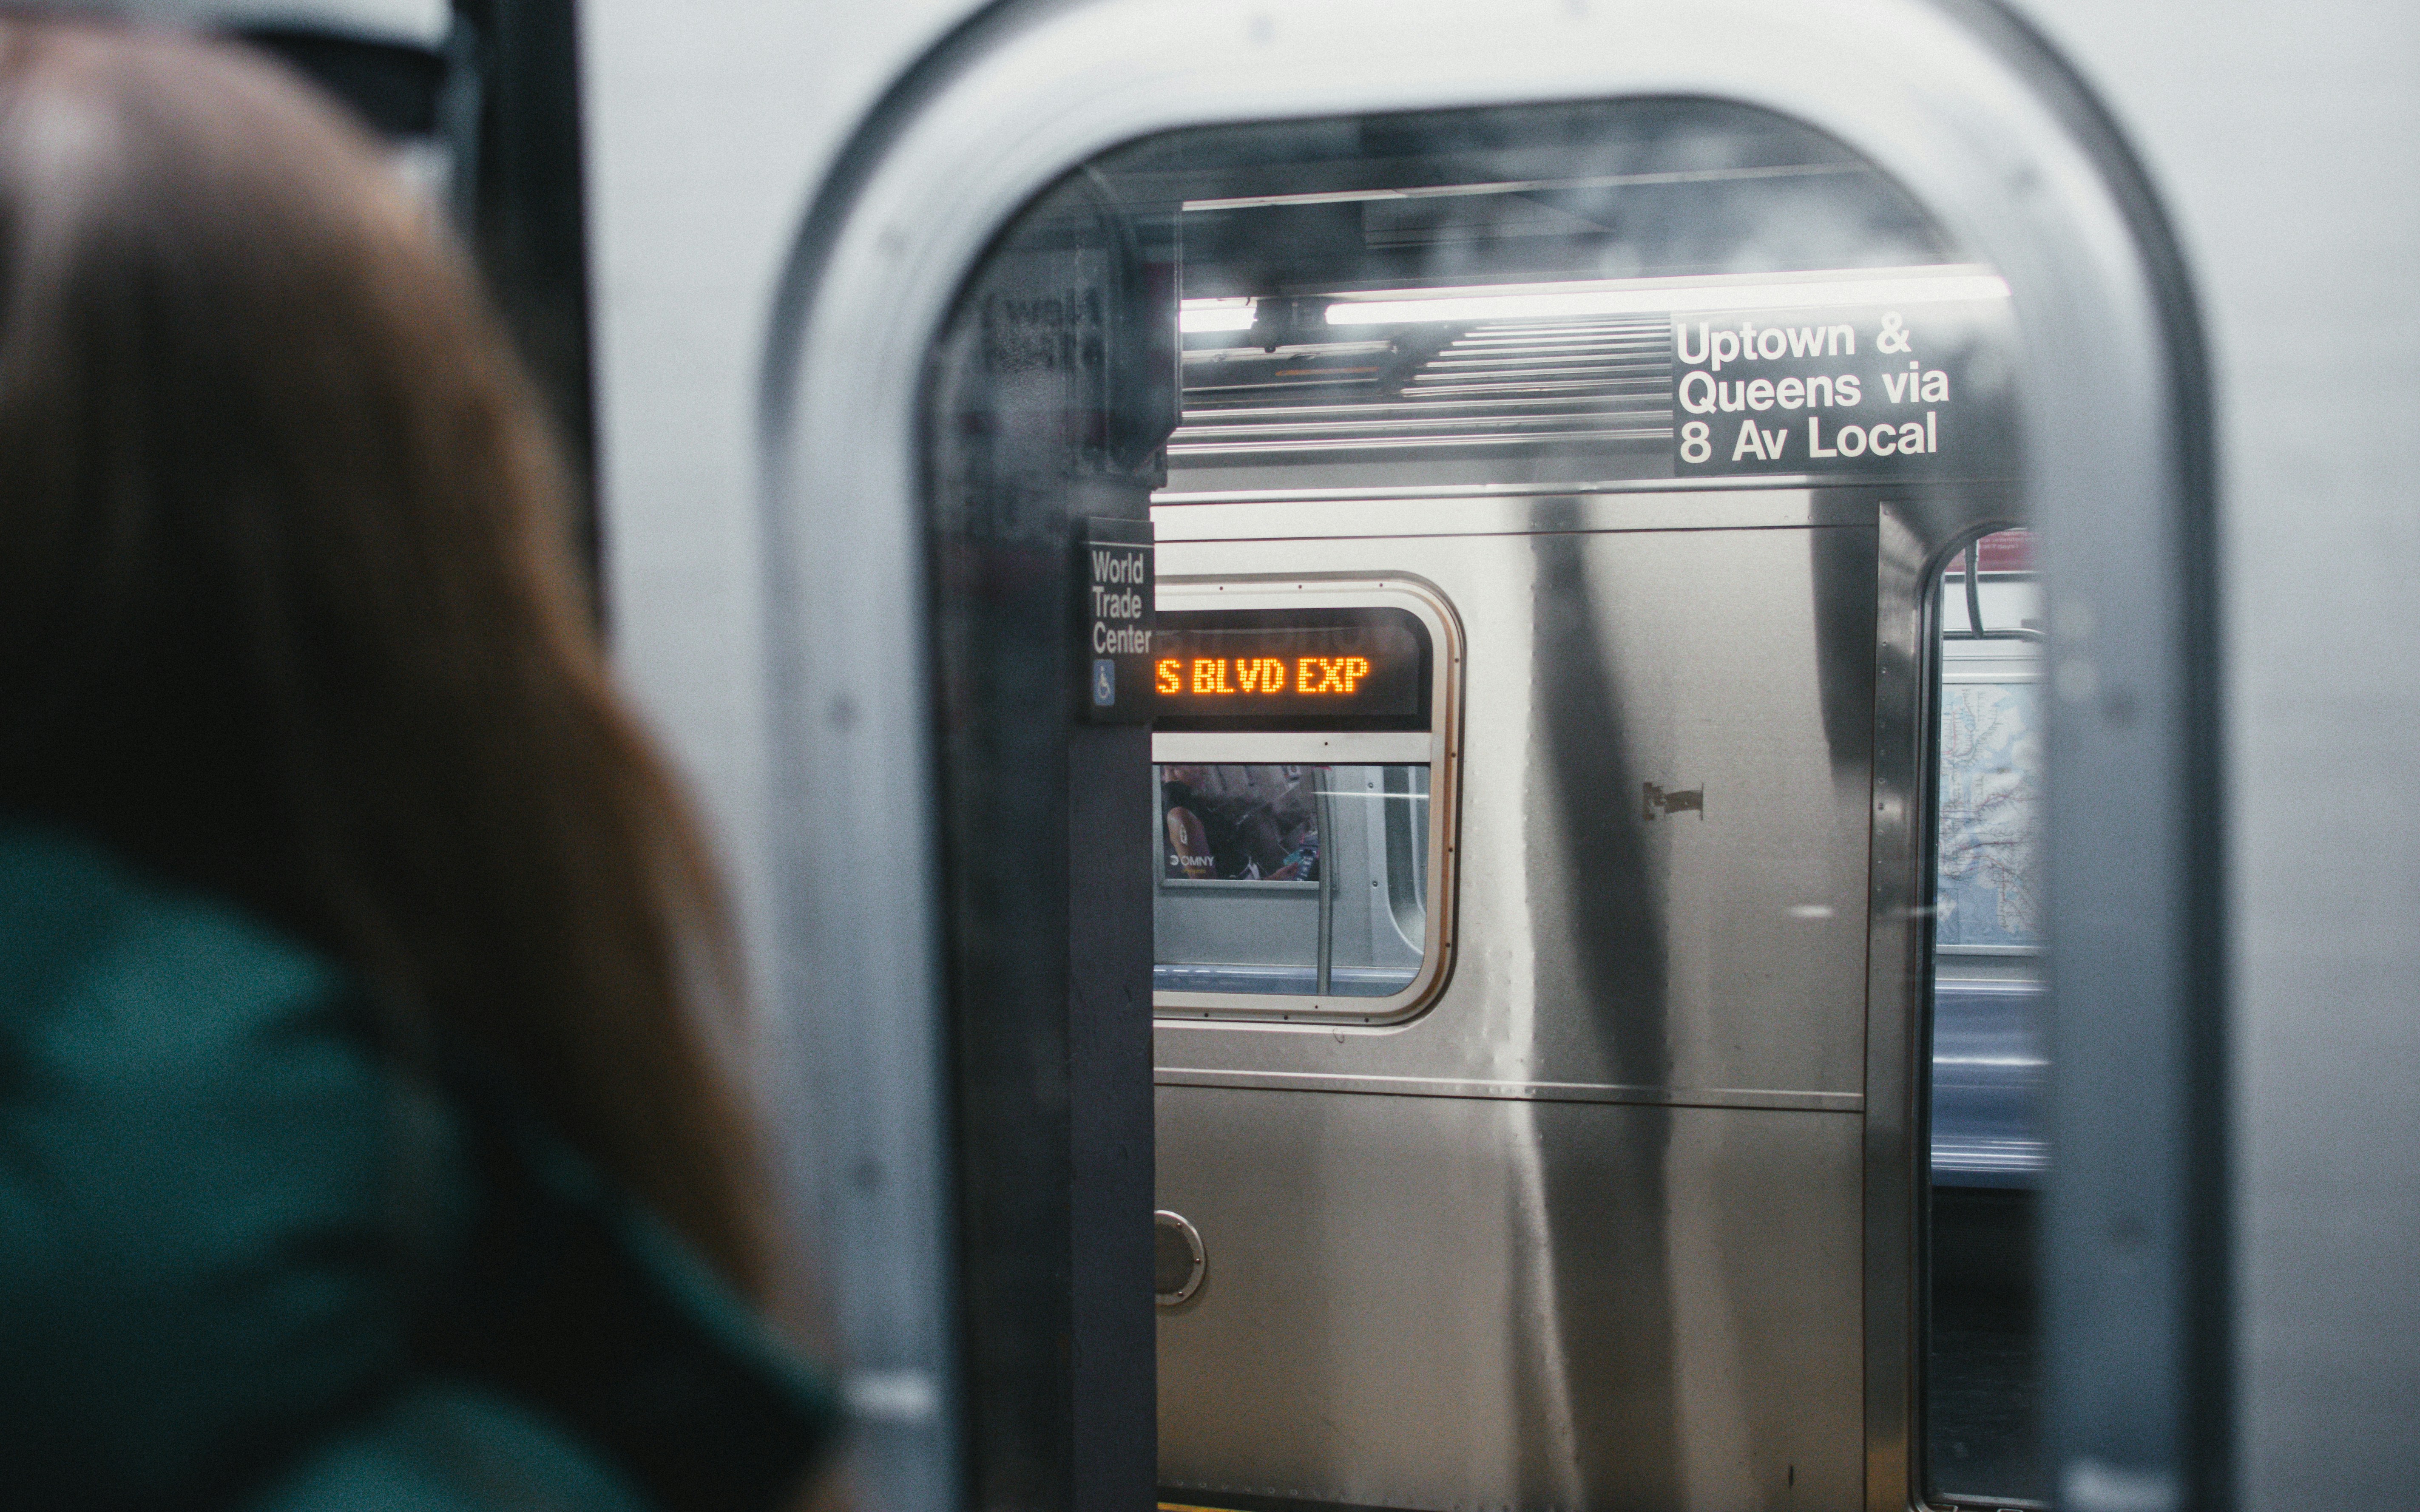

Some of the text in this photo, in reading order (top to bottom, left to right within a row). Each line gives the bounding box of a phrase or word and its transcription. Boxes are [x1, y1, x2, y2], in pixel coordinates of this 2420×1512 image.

[1677, 311, 1912, 371] Uptown &
[1679, 361, 1949, 414] Queens via
[1680, 411, 1937, 464] 8 Av Local
[1093, 550, 1144, 584] World
[1092, 586, 1142, 618] Trade
[1093, 621, 1152, 654] Center
[1193, 658, 1284, 693] BLVD
[1298, 657, 1368, 693] EXP
[1181, 855, 1214, 866] OMNY
